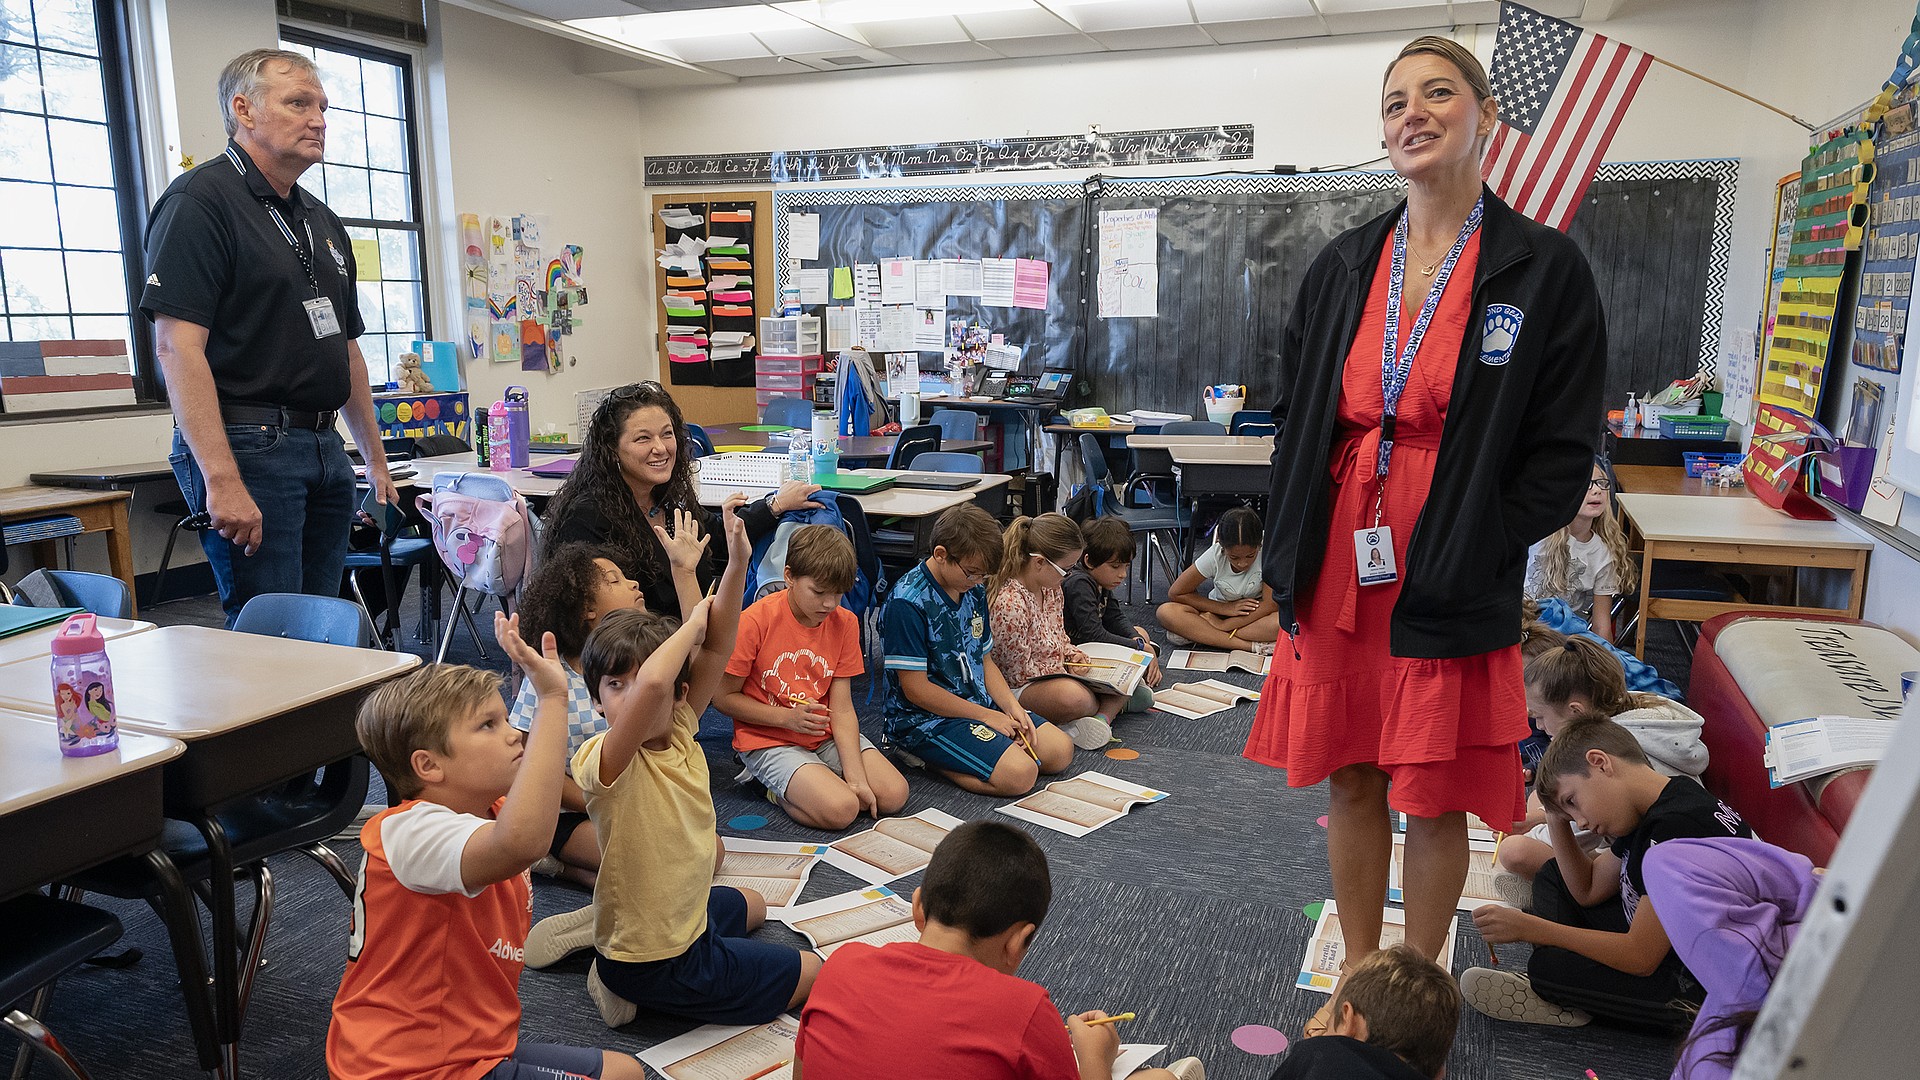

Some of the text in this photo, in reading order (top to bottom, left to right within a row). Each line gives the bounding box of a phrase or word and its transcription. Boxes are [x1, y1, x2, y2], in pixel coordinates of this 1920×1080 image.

[647, 162, 664, 175] Aa
[667, 162, 682, 175] Bb
[685, 161, 699, 174] Cc
[700, 160, 720, 174] Dd
[725, 160, 739, 173] Ee
[742, 158, 759, 178] Ff
[828, 155, 840, 175] Jj
[892, 150, 922, 165] Mm
[927, 149, 950, 163] Nn
[955, 148, 974, 162] Oo
[980, 146, 995, 166] Pp
[999, 145, 1020, 166] Qq
[1025, 143, 1044, 158] Rr
[1072, 141, 1090, 156] Tt
[1118, 138, 1139, 153] Vv
[1174, 134, 1199, 150] Xx
[1231, 131, 1250, 153] Zz
[1905, 203, 1909, 215] 8
[1103, 212, 1134, 226] Properties
[1393, 225, 1405, 277] SOMETHIN
[1390, 279, 1400, 298] SAY
[1886, 279, 1893, 291] 21
[1421, 303, 1436, 321] SAY
[1880, 315, 1890, 328] 28
[1395, 324, 1425, 385] SOMETHING
[1384, 366, 1393, 387] SEE
[488, 937, 525, 963] Adve
